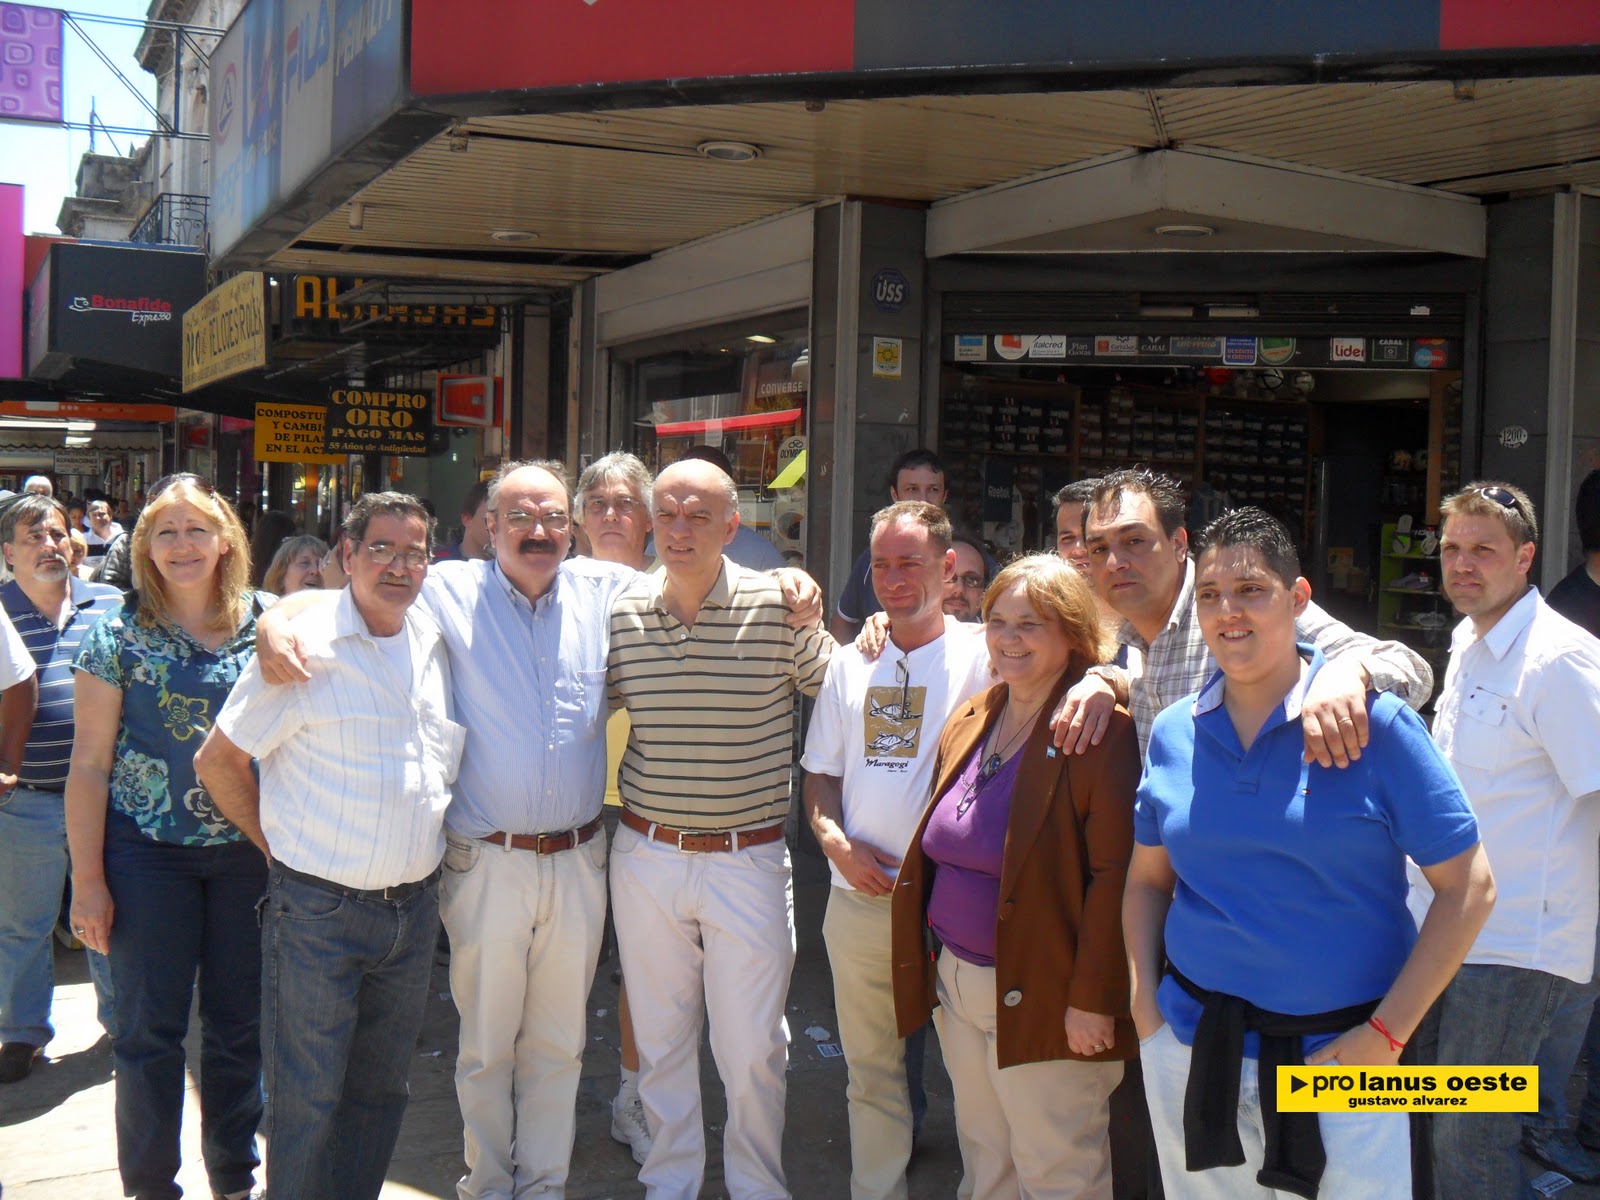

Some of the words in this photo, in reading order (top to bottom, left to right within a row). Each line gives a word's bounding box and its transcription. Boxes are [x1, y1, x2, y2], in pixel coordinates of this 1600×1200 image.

[91, 294, 171, 312] Bonafide
[131, 311, 172, 326] Expresso
[1033, 341, 1064, 349] italcred
[1071, 342, 1088, 350] Plan
[1141, 344, 1167, 352] CABAL
[760, 381, 803, 394] CONVERSE
[332, 390, 427, 409] COMPRO
[256, 408, 327, 421] COMPOSTU
[345, 408, 413, 428] ORO
[272, 421, 280, 430] Y
[274, 433, 290, 442] DE
[331, 428, 382, 439] PAGO
[388, 430, 425, 441] MAS
[1503, 428, 1522, 442] 1200
[266, 444, 283, 453] EN
[287, 445, 300, 454] EL
[303, 445, 326, 455] ACT
[328, 442, 340, 450] 55
[342, 441, 364, 451] Años
[365, 443, 376, 452] de
[865, 758, 909, 769] Maragogi
